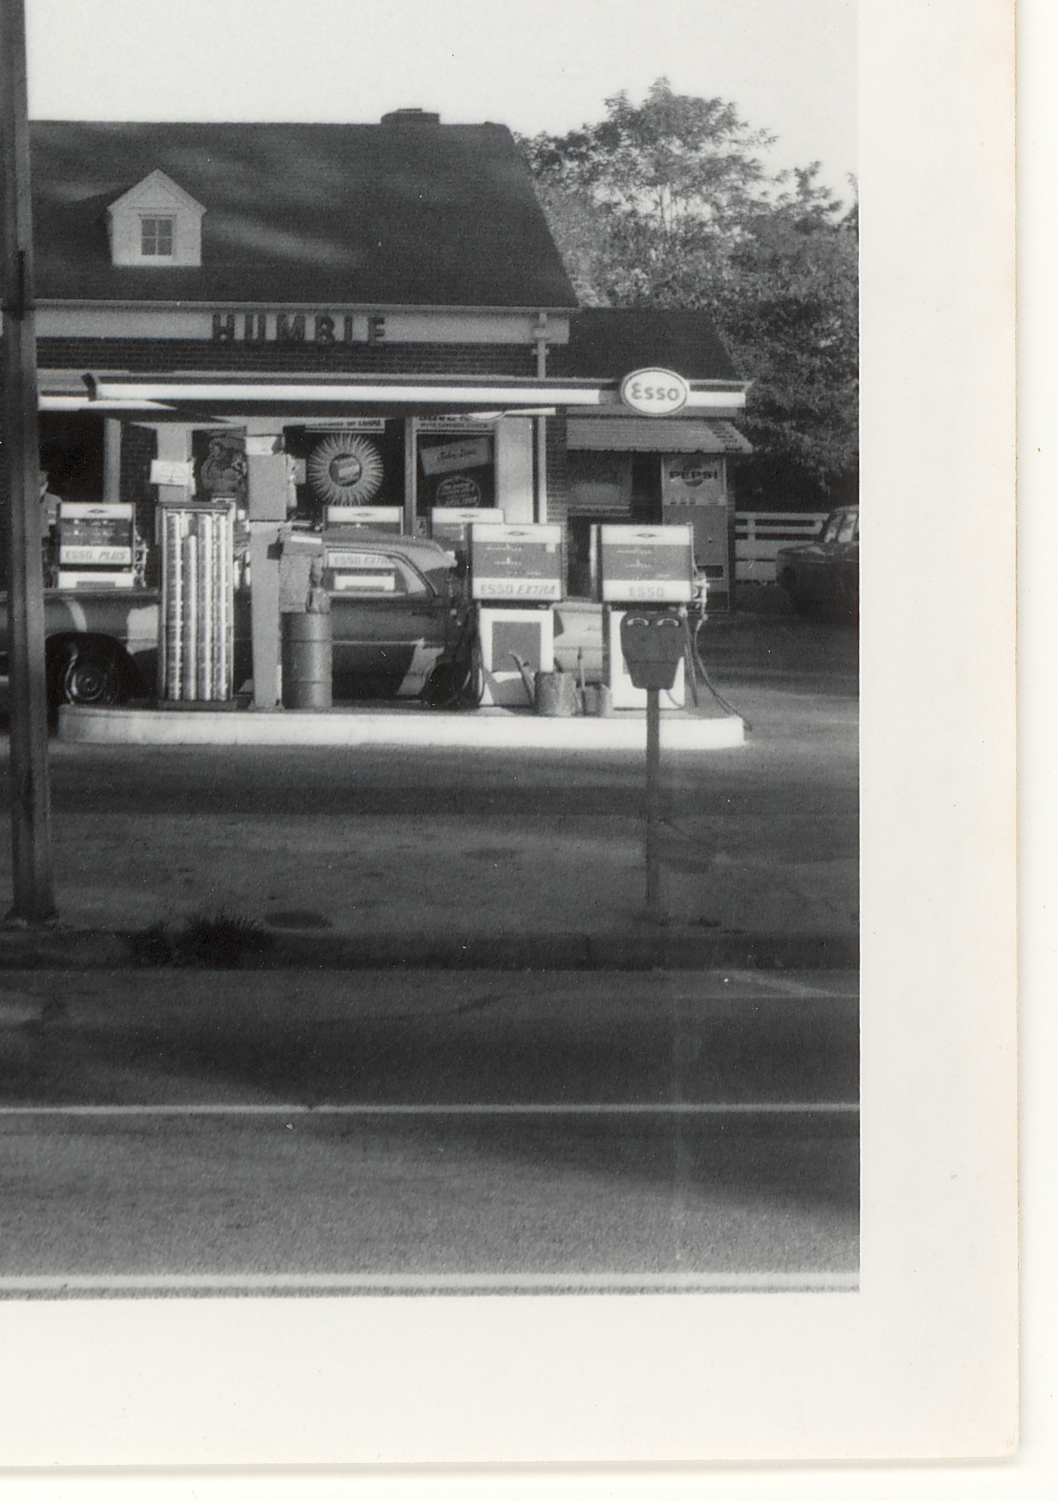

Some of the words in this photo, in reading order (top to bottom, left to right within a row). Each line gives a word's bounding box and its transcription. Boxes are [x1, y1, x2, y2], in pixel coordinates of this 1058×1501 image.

[212, 313, 386, 345] HUMBLE
[669, 469, 718, 480] PEPSI
[65, 550, 93, 561] ESSO
[98, 550, 128, 561] PLUS
[480, 584, 514, 596] ESSO
[628, 586, 665, 598] ESSO
